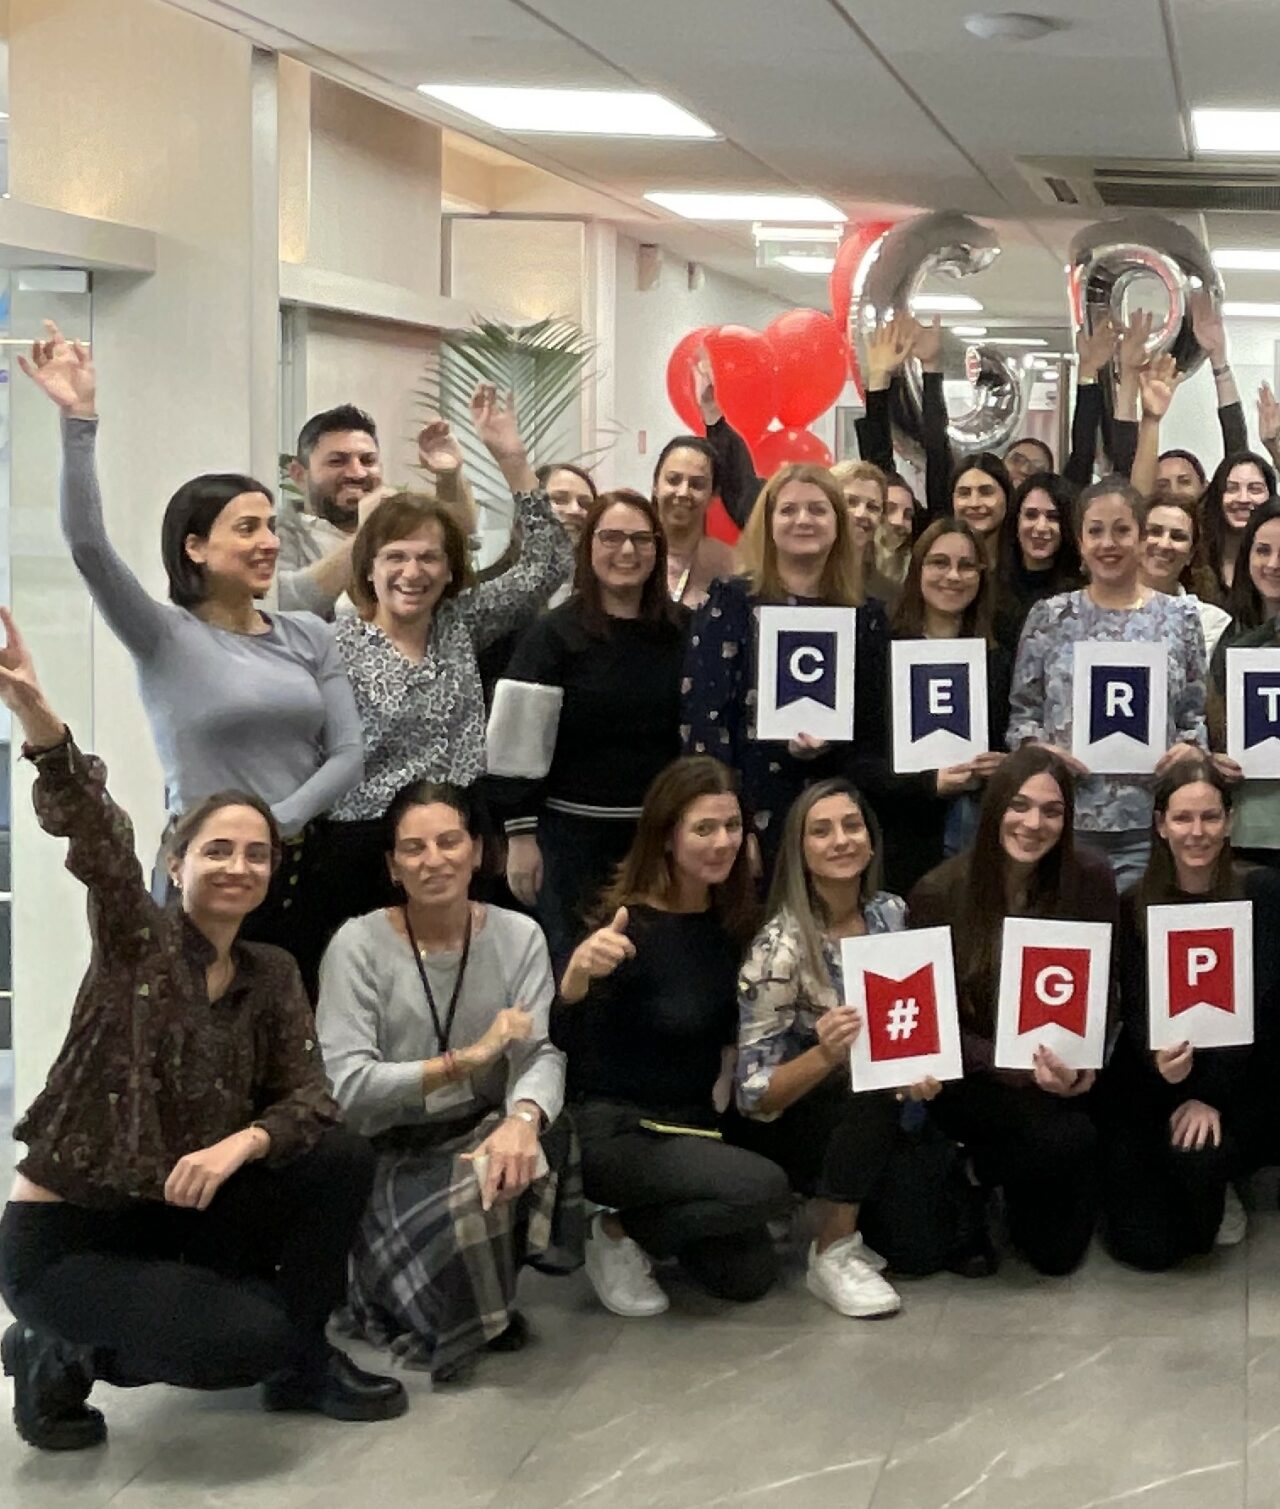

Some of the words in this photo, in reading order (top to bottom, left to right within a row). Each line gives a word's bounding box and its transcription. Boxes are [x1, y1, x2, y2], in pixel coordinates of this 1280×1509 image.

[850, 209, 1022, 460] G
[790, 647, 824, 682] C
[929, 679, 953, 714] E
[1106, 682, 1133, 716] R
[1035, 966, 1074, 1005] G
[1187, 948, 1217, 986] P
[886, 998, 919, 1040] #
